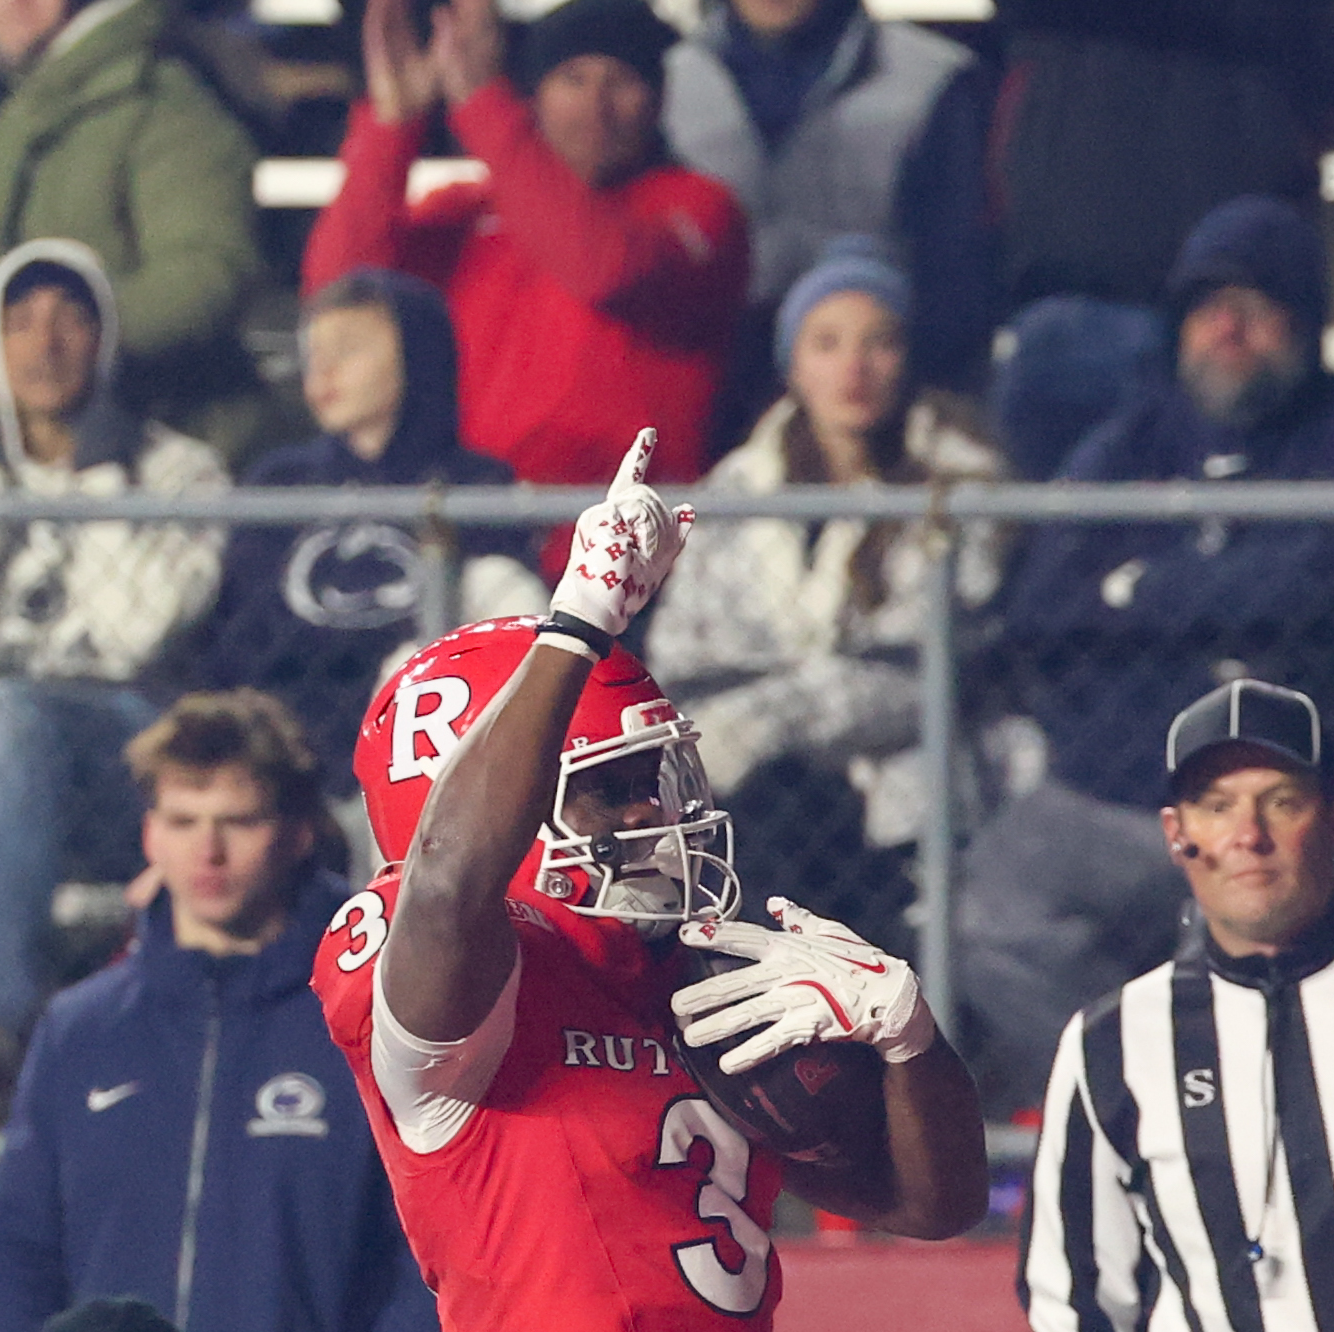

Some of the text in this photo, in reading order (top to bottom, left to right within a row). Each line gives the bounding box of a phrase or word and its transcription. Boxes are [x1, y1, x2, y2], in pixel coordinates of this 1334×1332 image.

[388, 675, 472, 784] R
[330, 889, 389, 973] 3
[563, 1027, 679, 1076] RUT
[1183, 1068, 1216, 1109] S
[653, 1092, 771, 1318] 3
